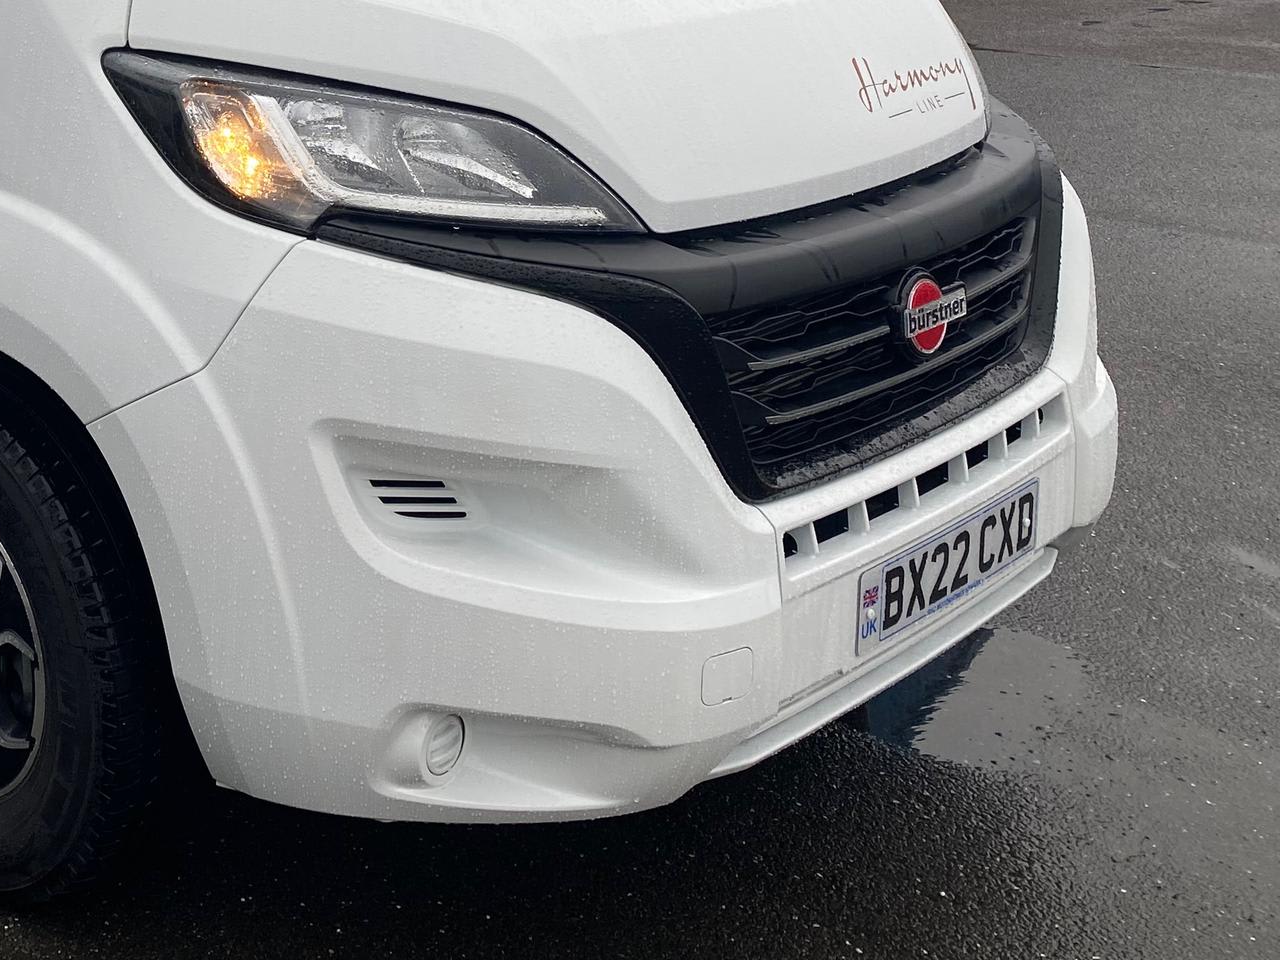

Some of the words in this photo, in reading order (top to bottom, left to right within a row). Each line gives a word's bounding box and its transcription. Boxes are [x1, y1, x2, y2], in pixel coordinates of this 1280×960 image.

[851, 57, 977, 113] Harmony
[916, 95, 944, 114] LINE
[909, 297, 966, 334] bürstner
[882, 530, 971, 631] BX22
[978, 492, 1035, 574] CXD
[861, 619, 878, 640] UK
